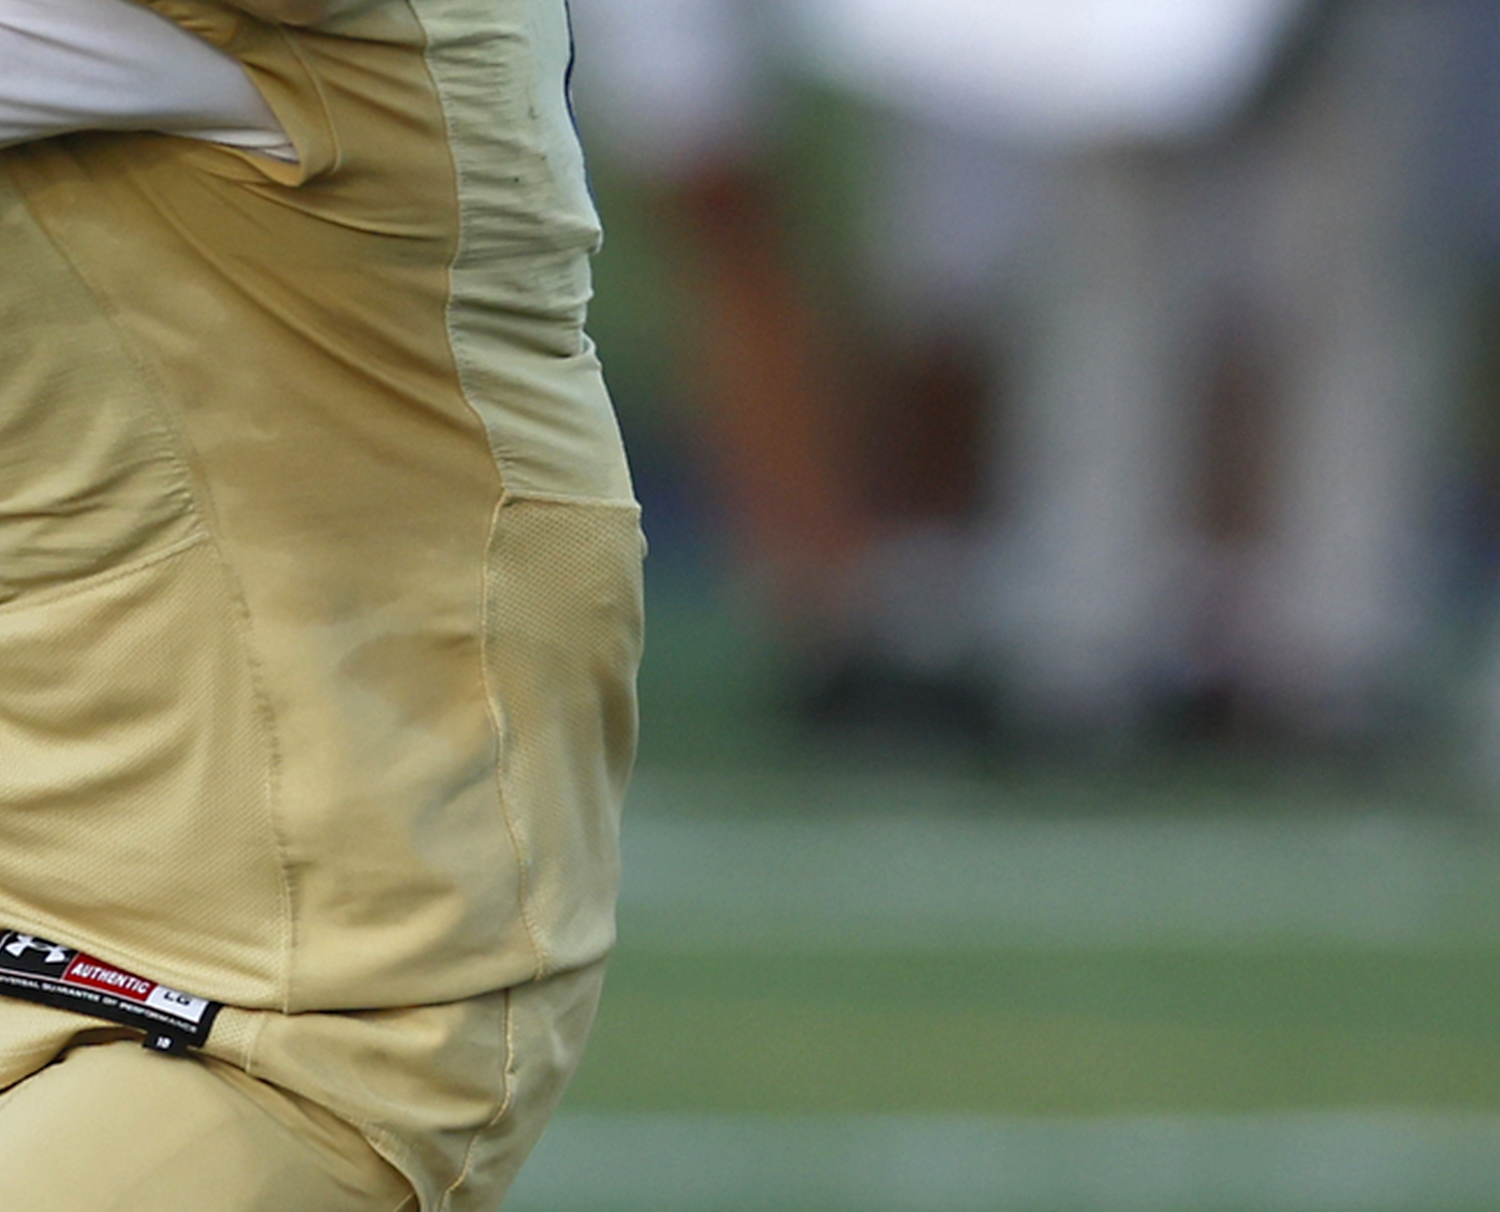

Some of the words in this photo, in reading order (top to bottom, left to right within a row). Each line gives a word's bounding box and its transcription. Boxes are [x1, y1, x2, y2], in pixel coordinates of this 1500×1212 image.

[70, 961, 151, 995] AUTHENTIC
[41, 981, 101, 1003] GUARANTEE
[102, 995, 118, 1007] OF
[119, 1001, 198, 1034] PERFORMANCE
